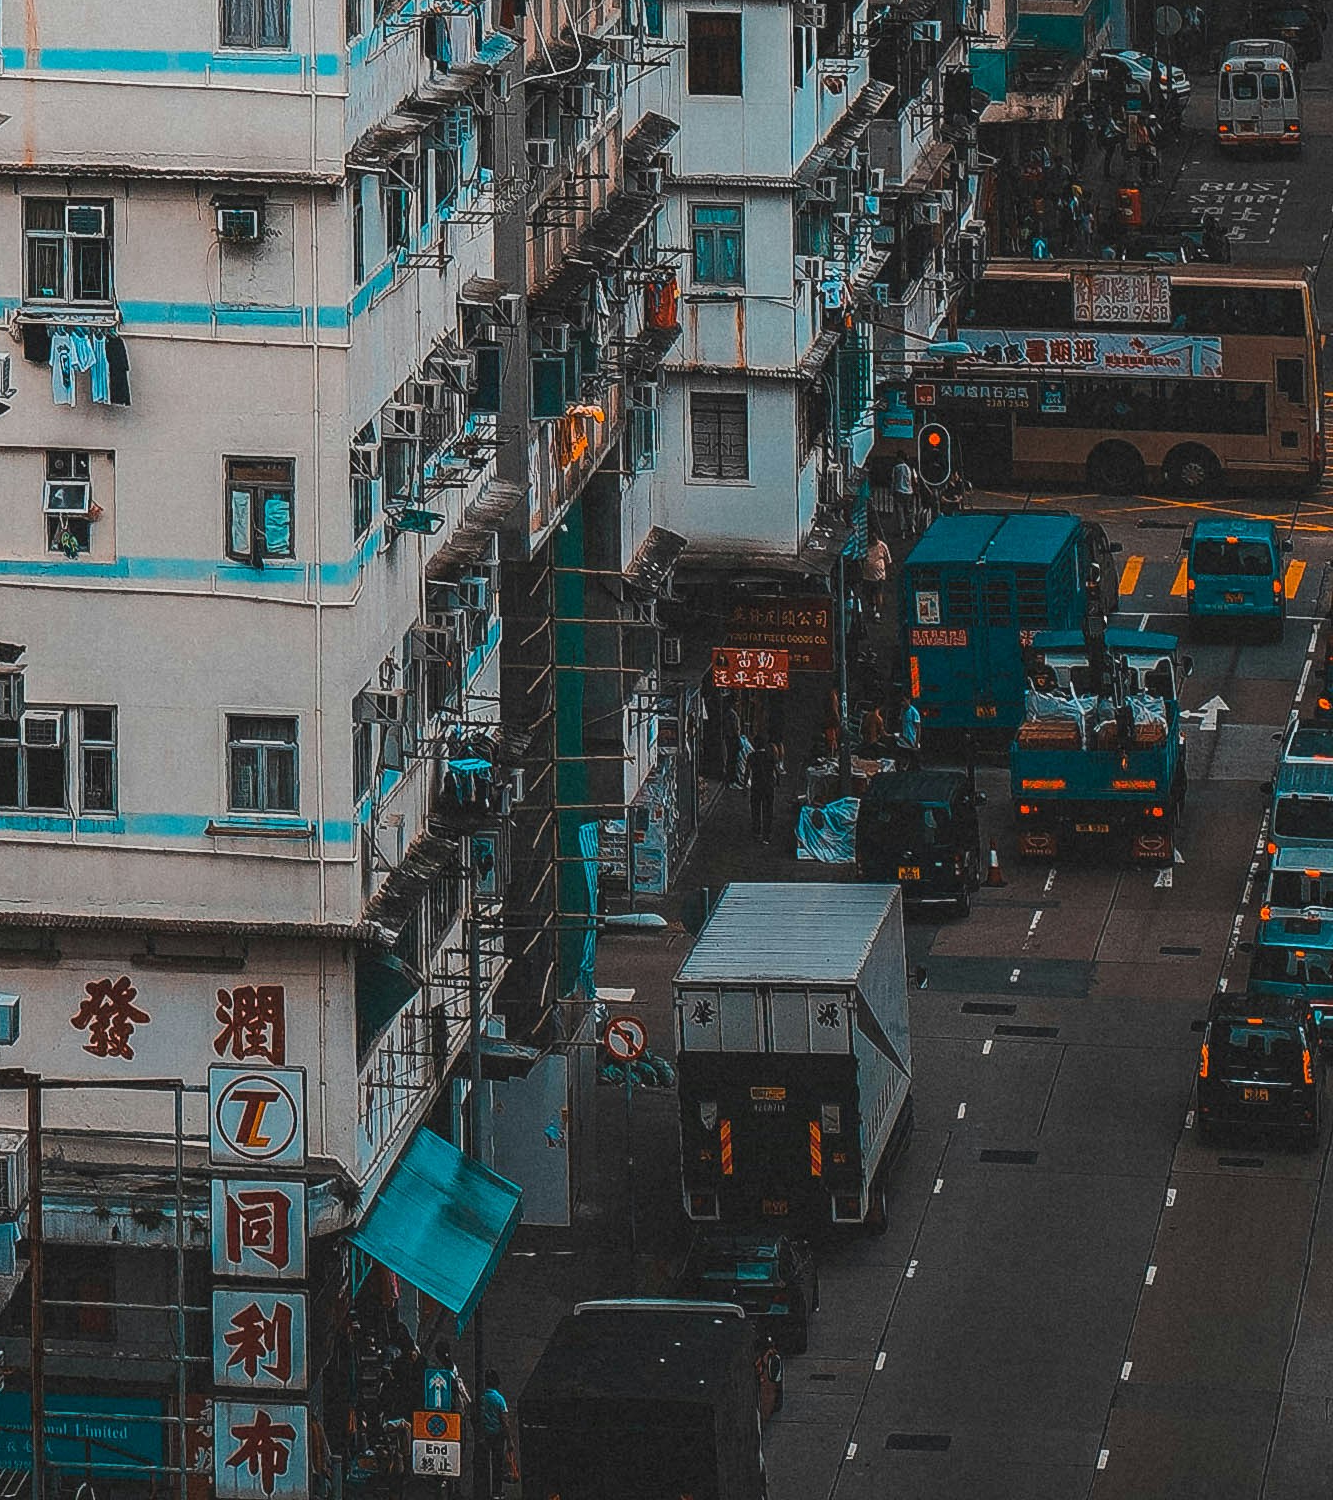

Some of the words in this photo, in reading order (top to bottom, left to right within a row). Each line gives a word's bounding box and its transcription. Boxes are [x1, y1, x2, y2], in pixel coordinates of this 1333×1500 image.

[1095, 305, 1129, 319] 2398
[75, 1423, 128, 1439] Limited
[426, 1444, 448, 1456] End
